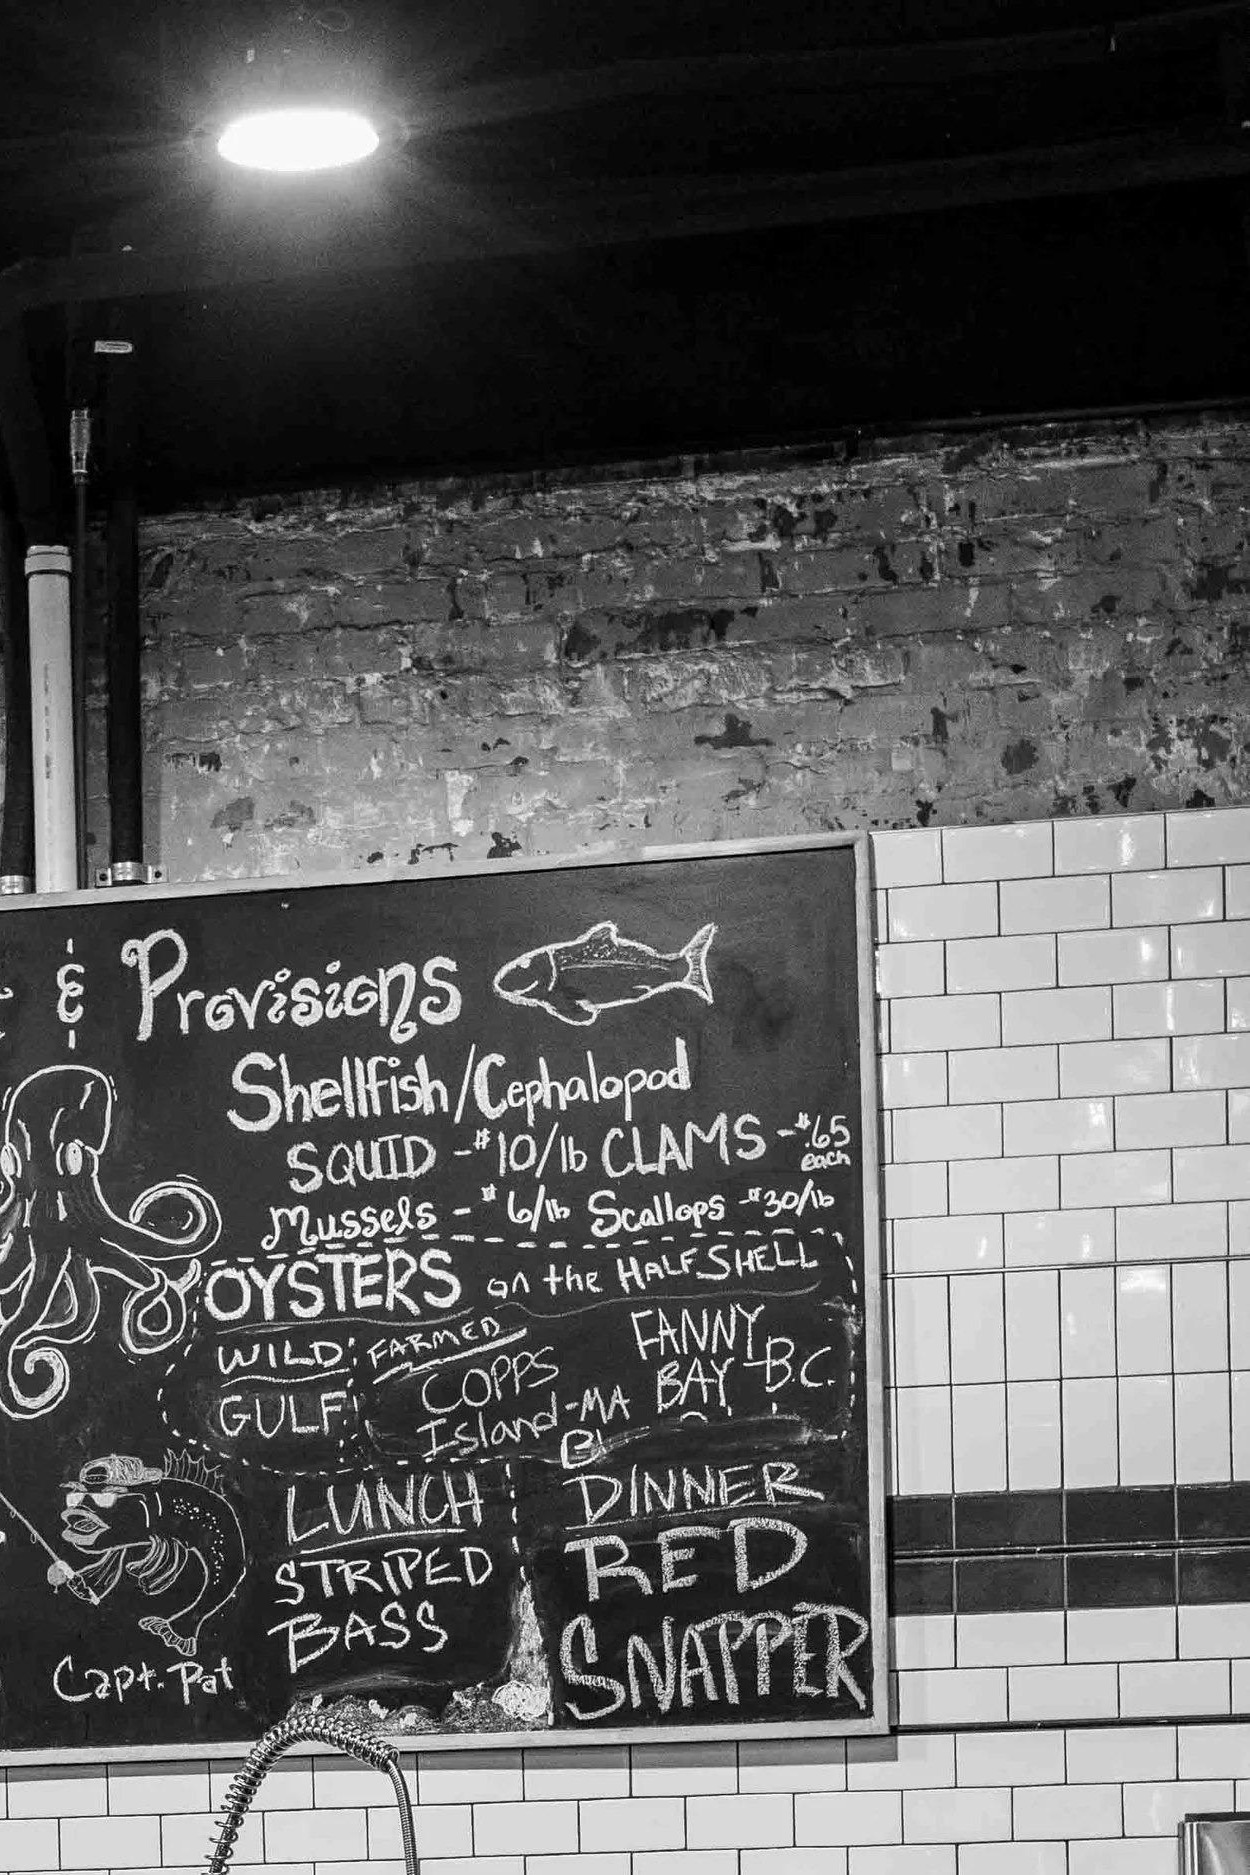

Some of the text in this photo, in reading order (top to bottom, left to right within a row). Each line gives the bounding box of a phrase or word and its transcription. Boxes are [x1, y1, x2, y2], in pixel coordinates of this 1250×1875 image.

[121, 929, 462, 1045] Provisions
[287, 1134, 436, 1194] SQUID
[601, 1112, 766, 1178] CLAMS
[801, 1144, 850, 1171] each
[588, 1190, 730, 1241] Scallops
[203, 1248, 463, 1324] OYSTERS
[543, 1264, 603, 1295] the
[617, 1241, 698, 1294] HALF
[696, 1241, 818, 1280] SHELL
[218, 1340, 348, 1381] WILD
[368, 1317, 502, 1367] FARMED
[630, 1303, 765, 1360] FANNY
[422, 1346, 559, 1414] COPPS
[657, 1357, 734, 1414] BAY
[213, 1391, 347, 1439] GULF
[417, 1393, 558, 1458] Island
[287, 1465, 484, 1549] LUNCH
[563, 1455, 824, 1530] DINNER
[275, 1546, 492, 1605] STRIPED
[564, 1511, 807, 1601] RED
[267, 1600, 448, 1681] BASS
[560, 1602, 868, 1719] SNAPPER
[54, 1656, 233, 1705] Capt. Pat
